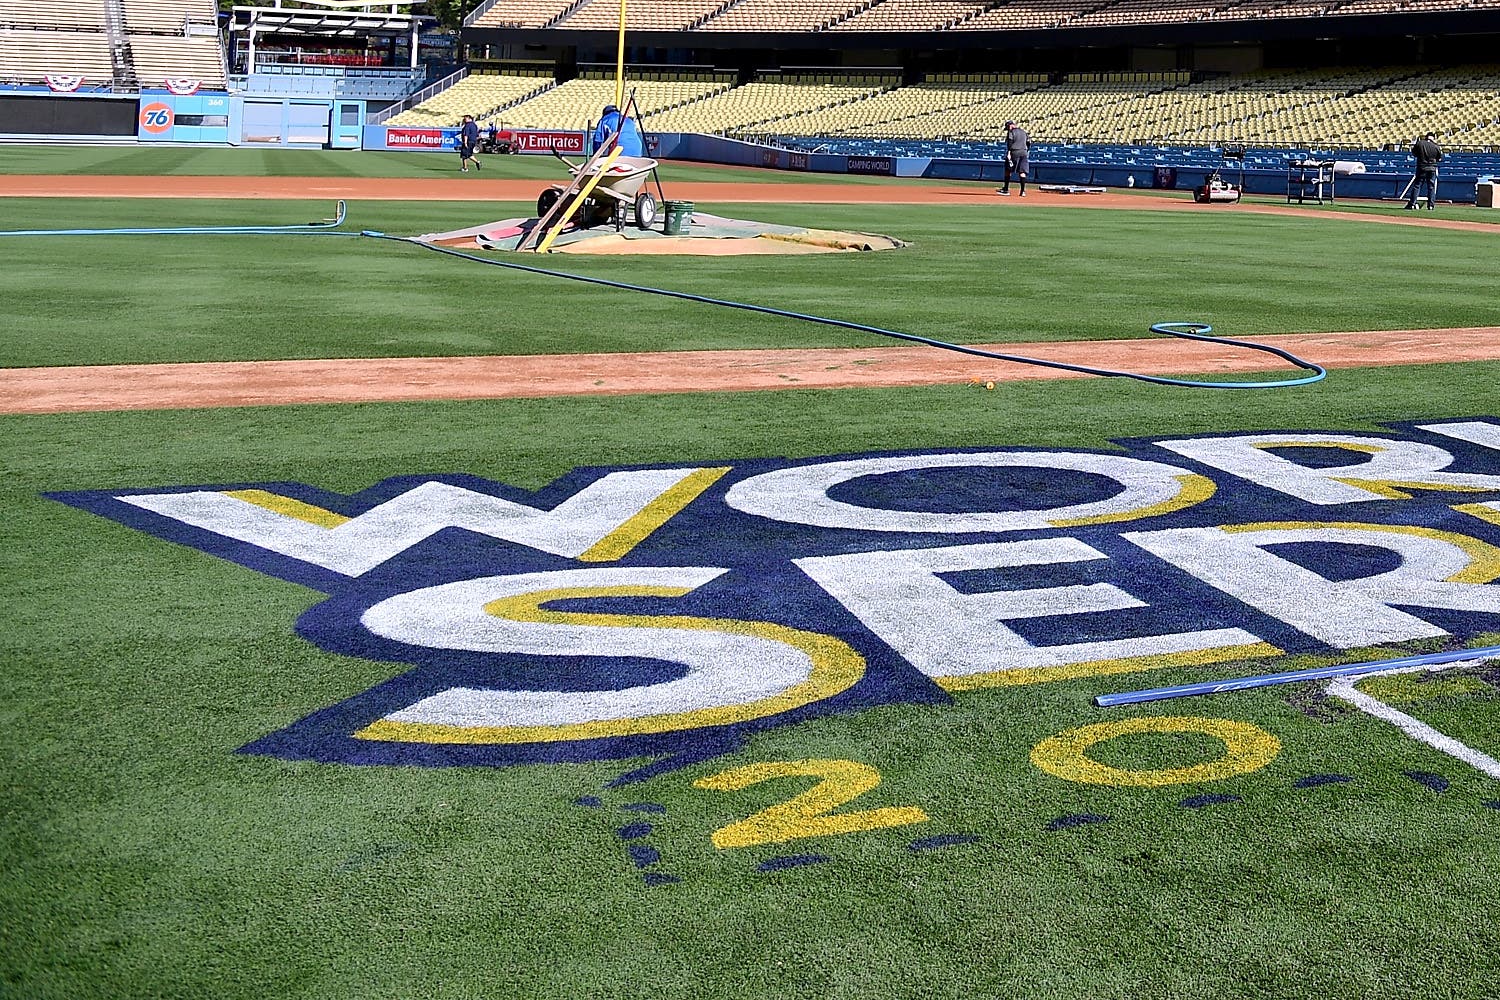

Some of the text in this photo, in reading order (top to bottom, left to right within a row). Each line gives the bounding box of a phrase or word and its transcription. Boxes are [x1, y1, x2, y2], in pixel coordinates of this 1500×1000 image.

[144, 109, 169, 127] 76
[388, 134, 454, 145] Bank of America
[529, 134, 579, 148] Emirates
[848, 160, 890, 170] CAMPING WORLD
